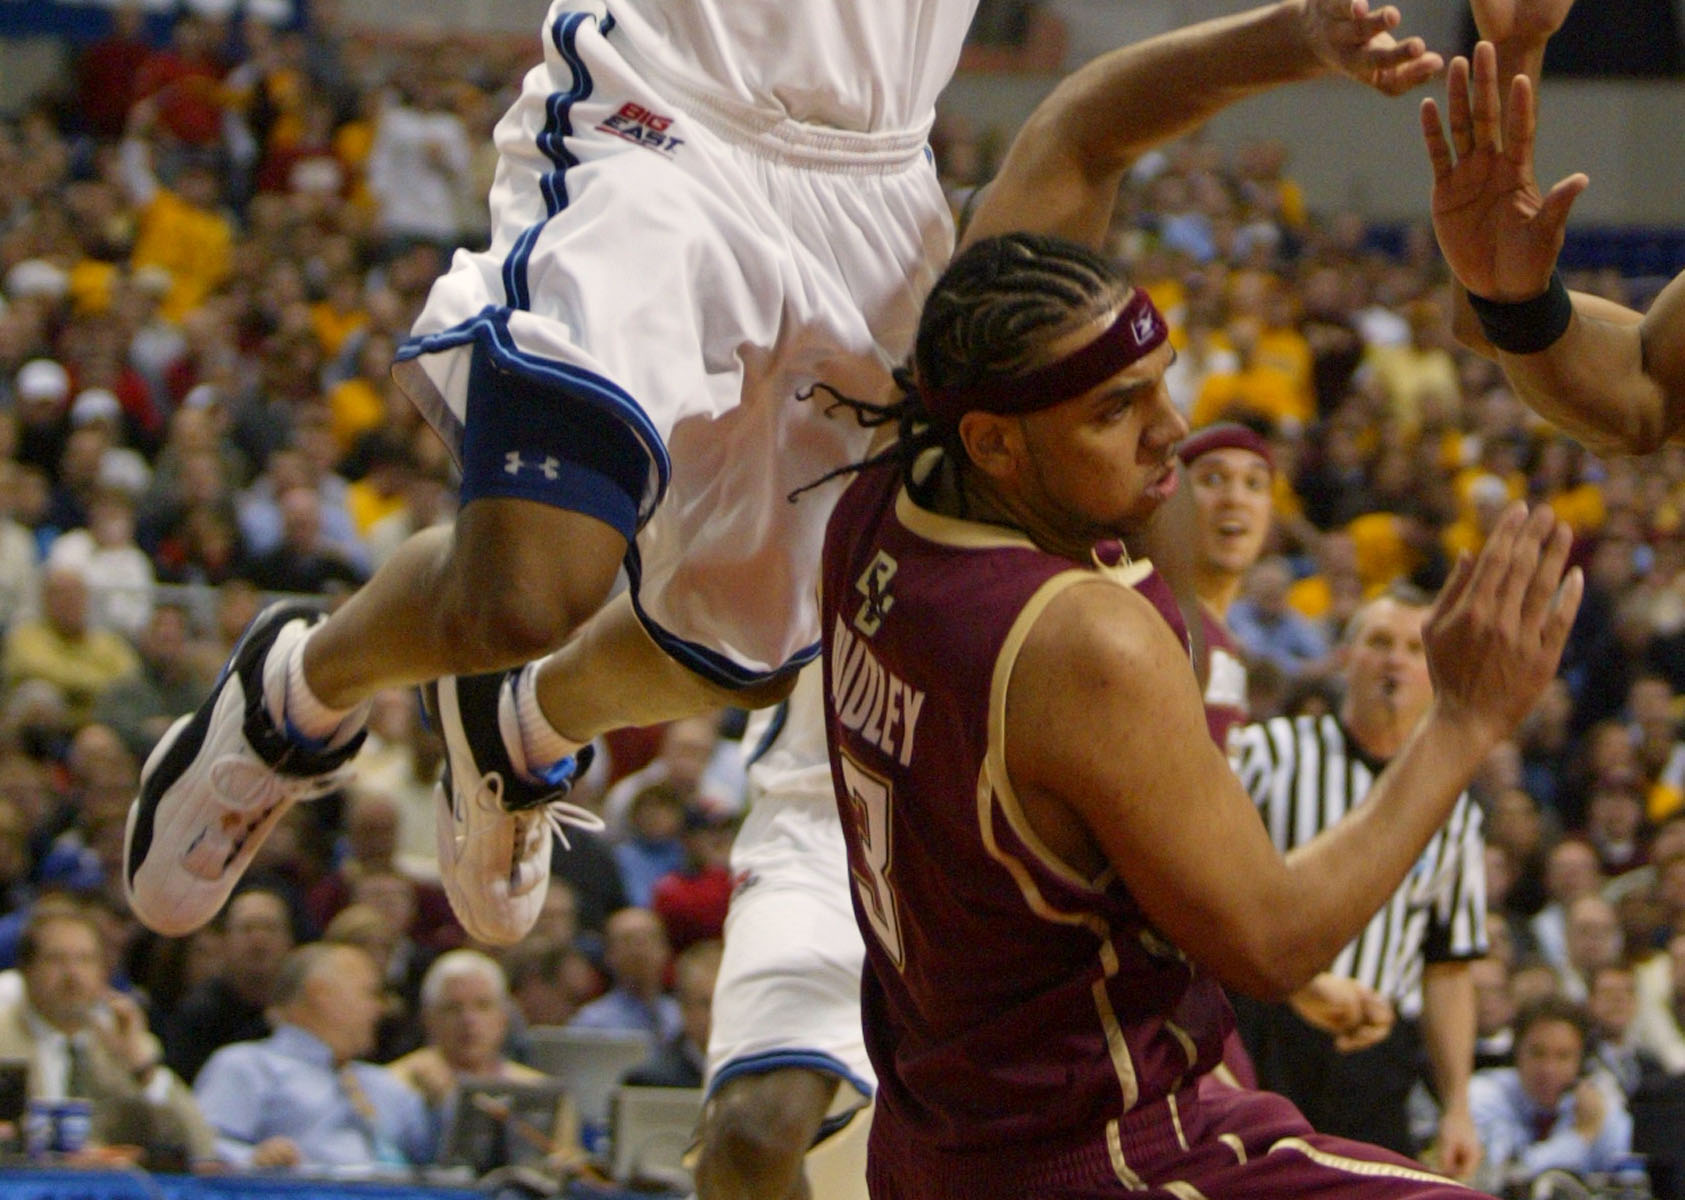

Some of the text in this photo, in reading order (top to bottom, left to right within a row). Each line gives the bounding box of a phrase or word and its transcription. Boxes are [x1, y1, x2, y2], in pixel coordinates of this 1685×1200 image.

[602, 114, 685, 151] EAST
[618, 102, 674, 132] BIG
[839, 745, 906, 974] 3
